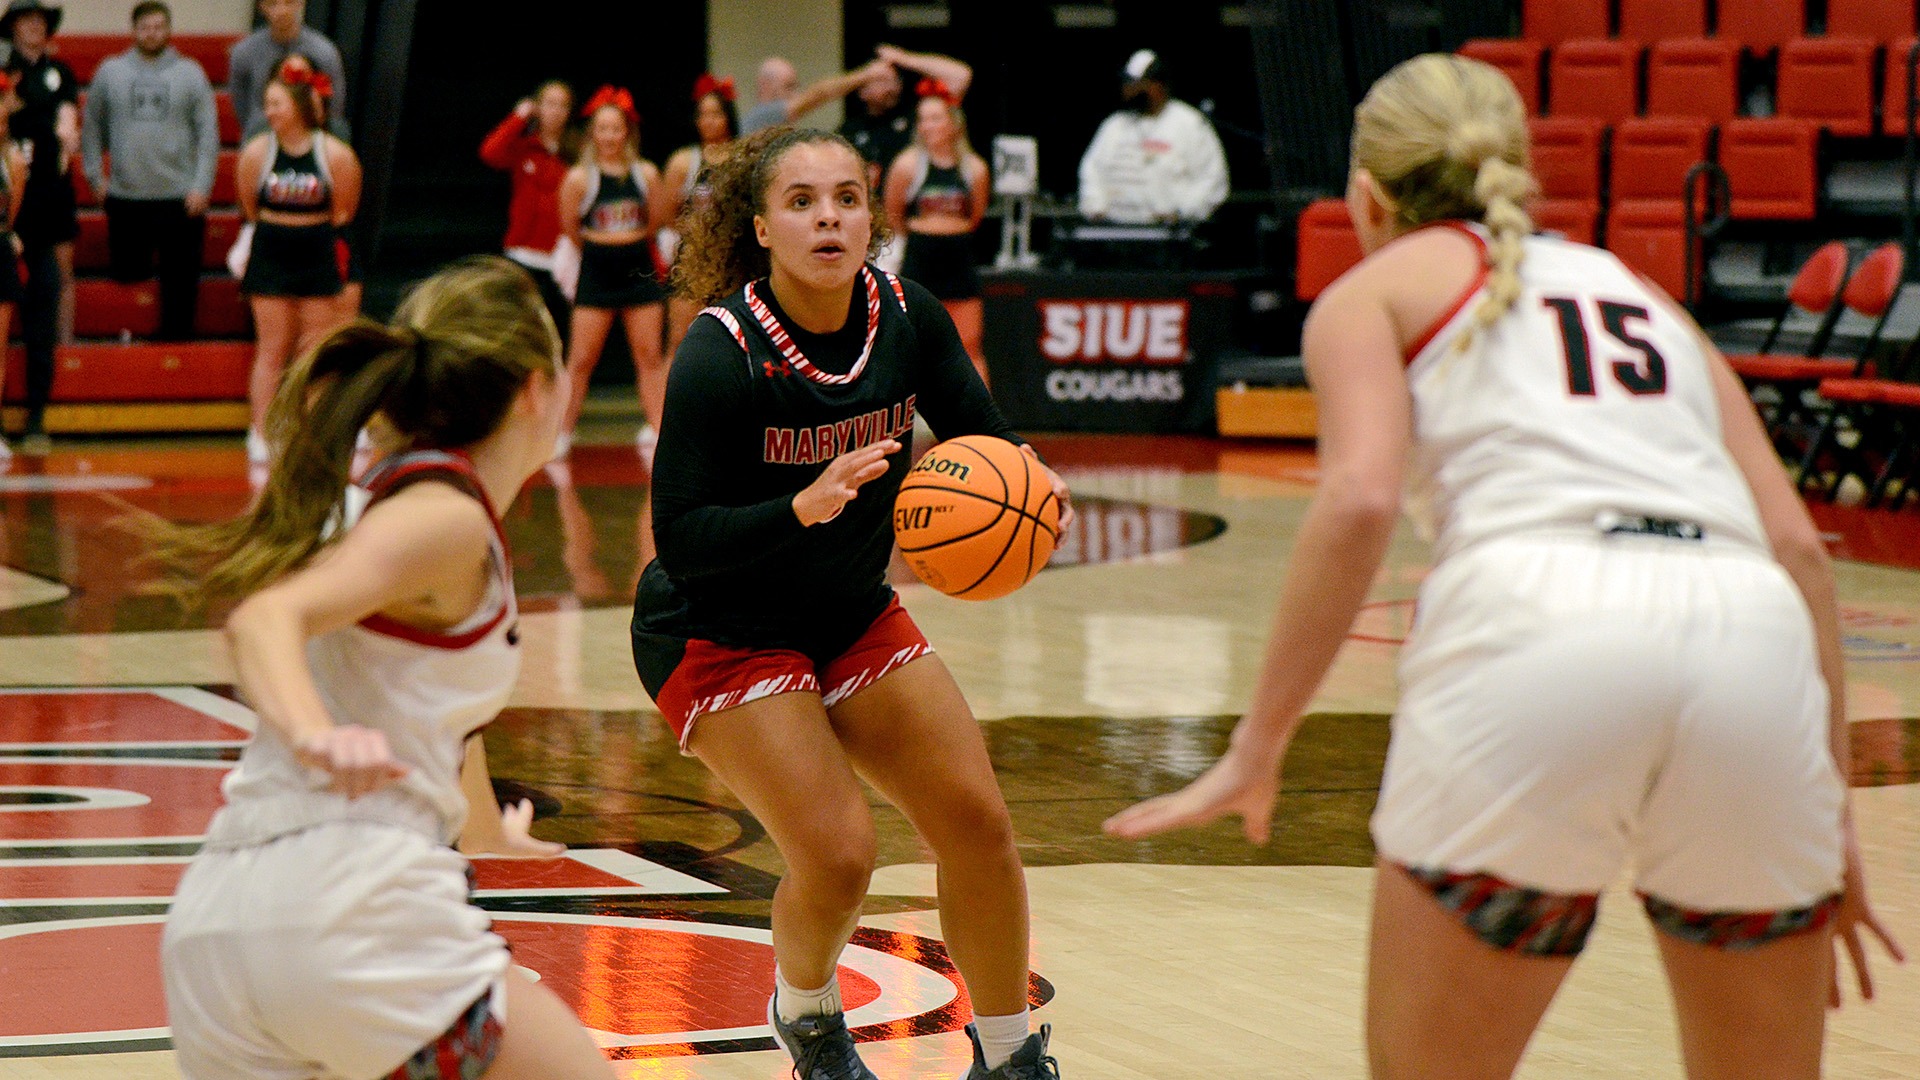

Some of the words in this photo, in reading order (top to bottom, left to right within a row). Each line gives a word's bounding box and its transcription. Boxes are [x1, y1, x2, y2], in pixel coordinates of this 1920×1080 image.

[1040, 300, 1187, 361] SIUE
[1543, 298, 1667, 396] 15
[1046, 370, 1184, 401] COUGARS
[763, 394, 916, 465] MARYVILLE
